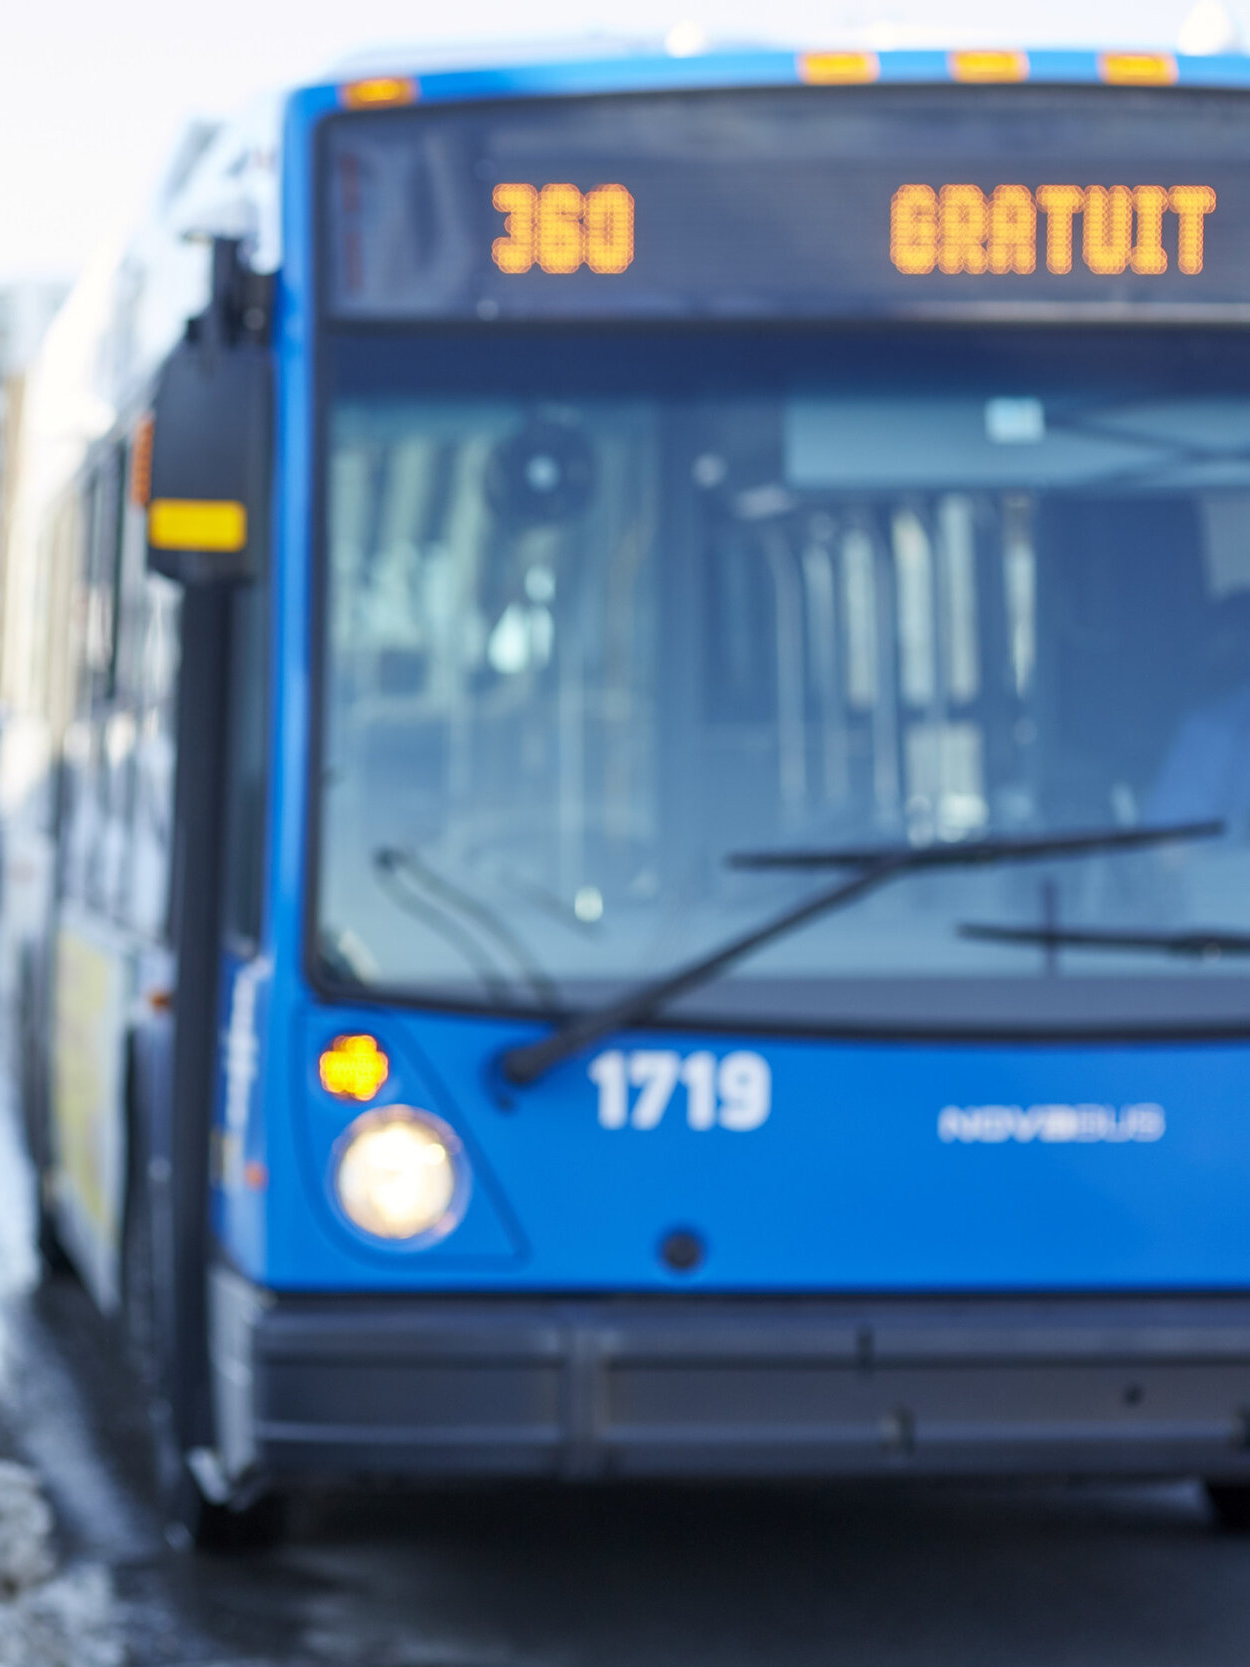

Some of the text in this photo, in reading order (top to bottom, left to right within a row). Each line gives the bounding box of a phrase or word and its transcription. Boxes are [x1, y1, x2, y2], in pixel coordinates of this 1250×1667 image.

[492, 184, 1216, 274] 360 GRATUIT
[589, 1051, 771, 1130] 1719
